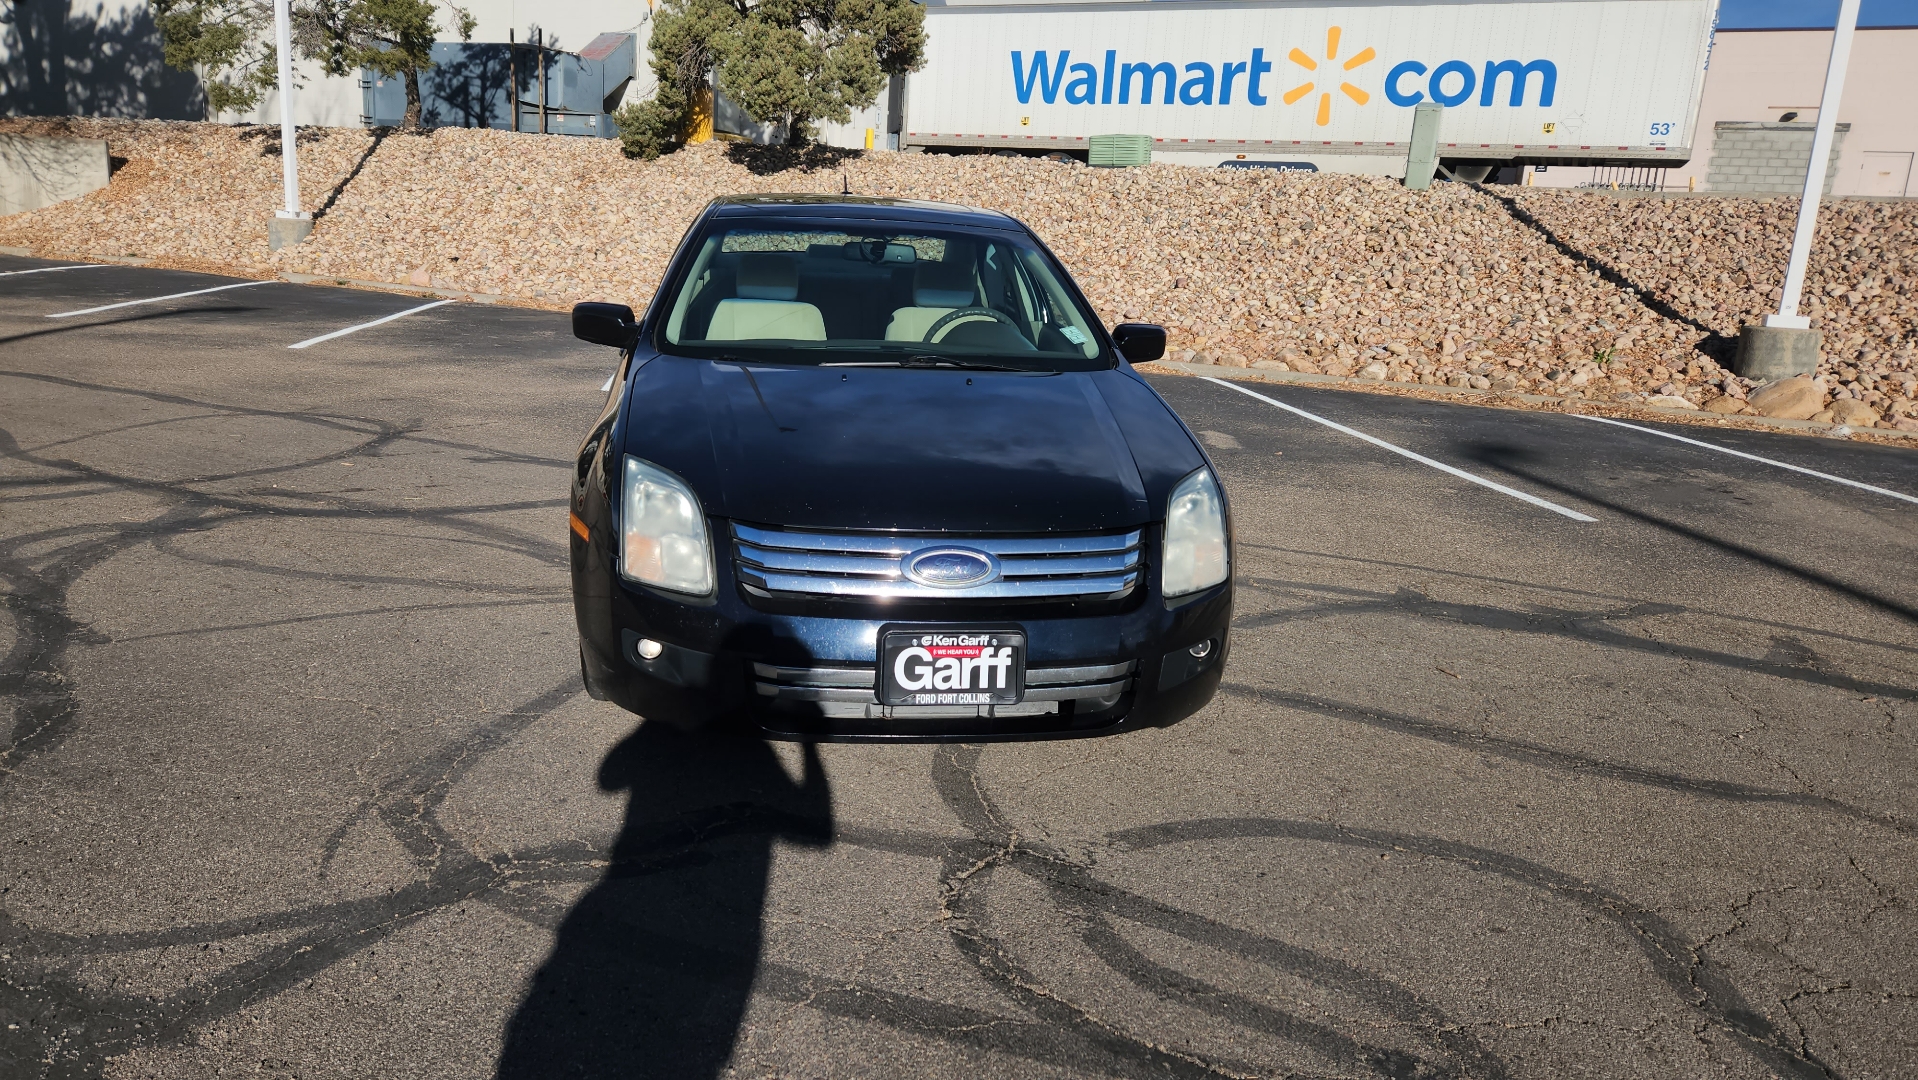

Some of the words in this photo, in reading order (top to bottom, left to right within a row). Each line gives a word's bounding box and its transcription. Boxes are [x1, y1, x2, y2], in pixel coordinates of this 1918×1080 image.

[1011, 48, 1272, 106] Walmart
[1384, 59, 1557, 107] com
[1250, 165, 1278, 173] Hiri
[932, 634, 958, 646] Ken
[957, 634, 990, 646] Garff
[894, 646, 1012, 691] Garff
[915, 693, 936, 705] FORD
[937, 693, 957, 704] FORT
[958, 692, 991, 704] COLLINS
